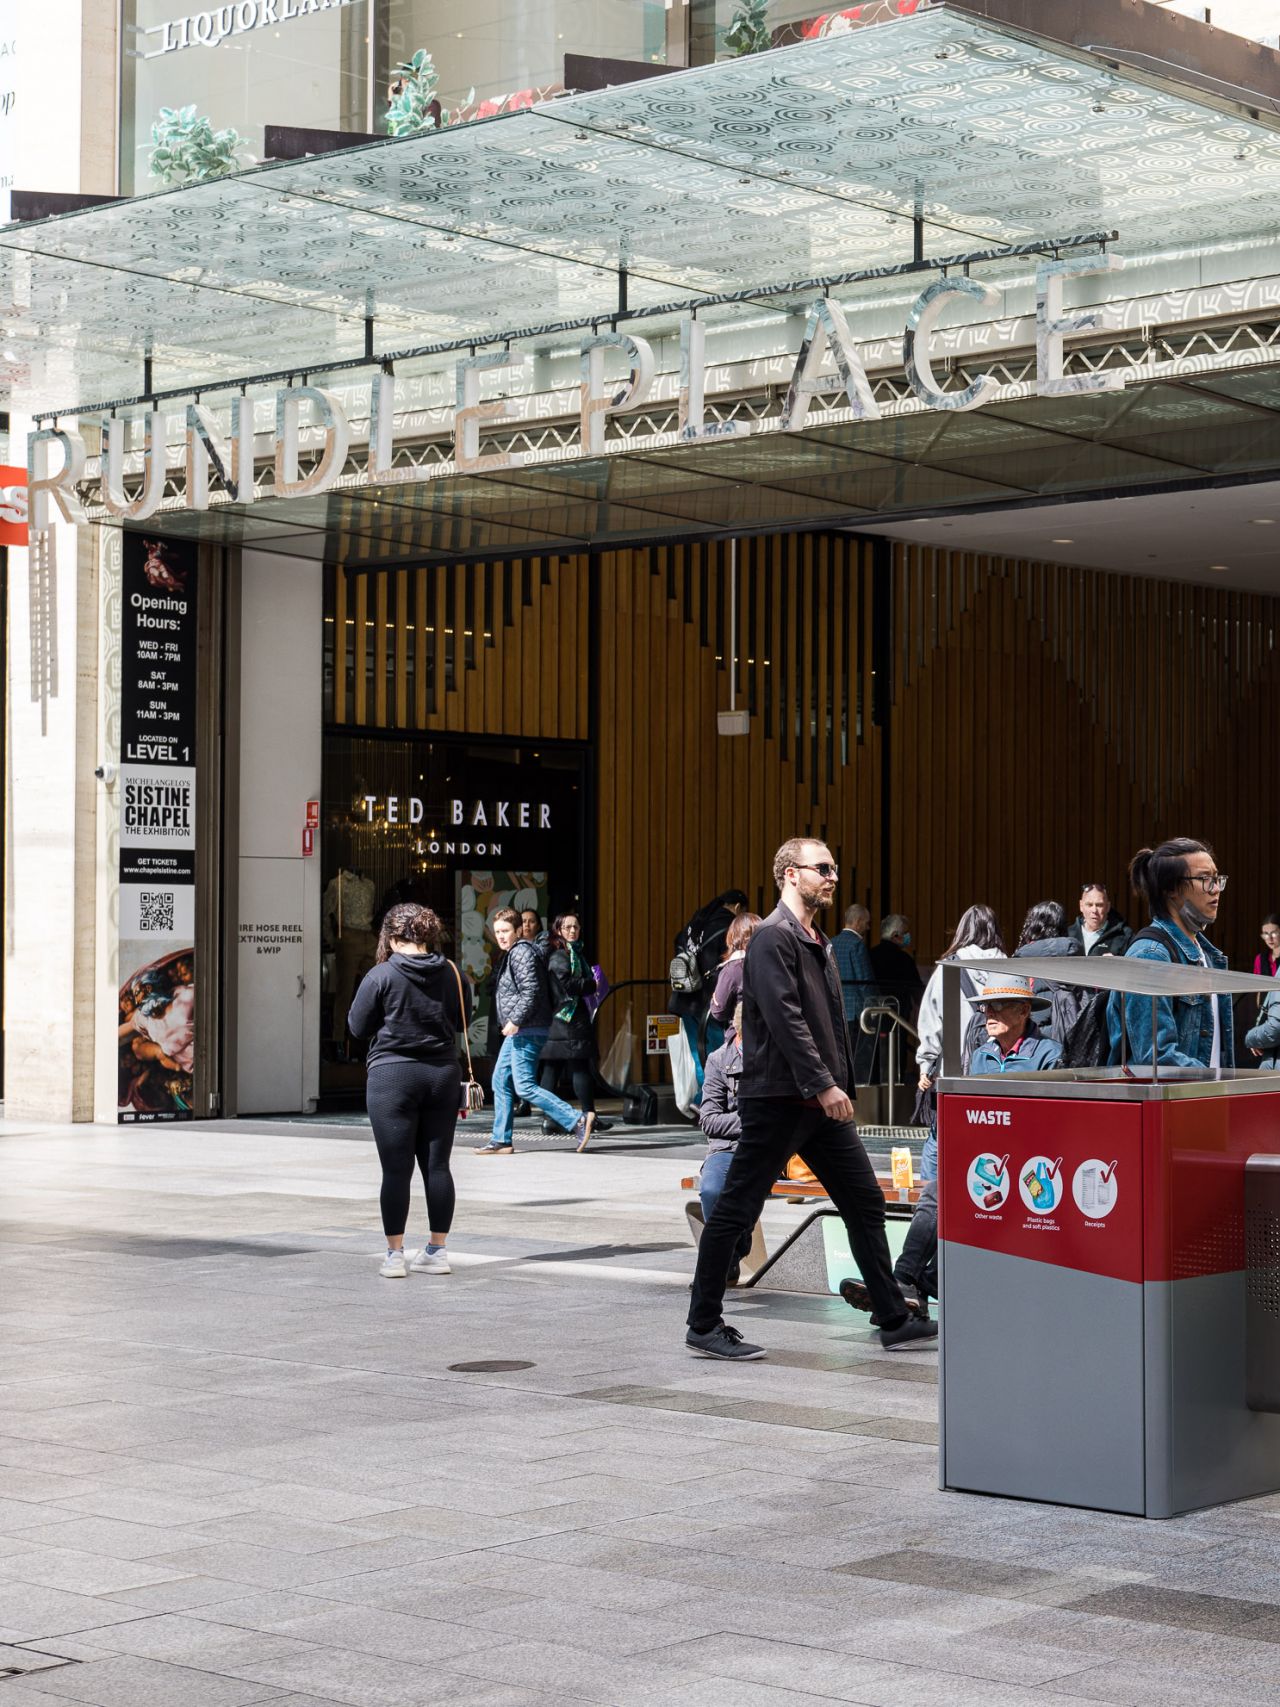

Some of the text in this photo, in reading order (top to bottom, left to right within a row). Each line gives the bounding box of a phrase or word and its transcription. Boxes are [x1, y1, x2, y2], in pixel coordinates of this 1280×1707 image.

[27, 253, 1124, 531] RUNDLE PLACE
[131, 593, 187, 614] Opening
[137, 613, 180, 630] Hours:
[139, 640, 158, 650] WED
[165, 643, 178, 652] FRI
[136, 650, 158, 660] 10AM
[164, 652, 181, 662] 7PM
[150, 671, 166, 680] SAT
[138, 680, 155, 690] 8AM
[162, 682, 178, 691] 3PM
[149, 701, 167, 710] SUN
[136, 710, 157, 719] 11AM
[163, 712, 180, 721] 3PM
[139, 734, 167, 743] LOCATED
[127, 743, 189, 762] LEVEL 1
[125, 785, 190, 807] SISTINE
[125, 805, 190, 828] CHAPEL
[364, 796, 551, 829] TED BAKER
[125, 826, 190, 837] THE EXHIBITION
[417, 841, 502, 856] LONDON
[151, 858, 177, 866] TICKETS
[124, 866, 191, 875] www.chapelsistine.com
[239, 924, 303, 932] IRE HOSE REEL
[239, 935, 302, 943] XTINGUISHER
[966, 1110, 1011, 1126] WASTE
